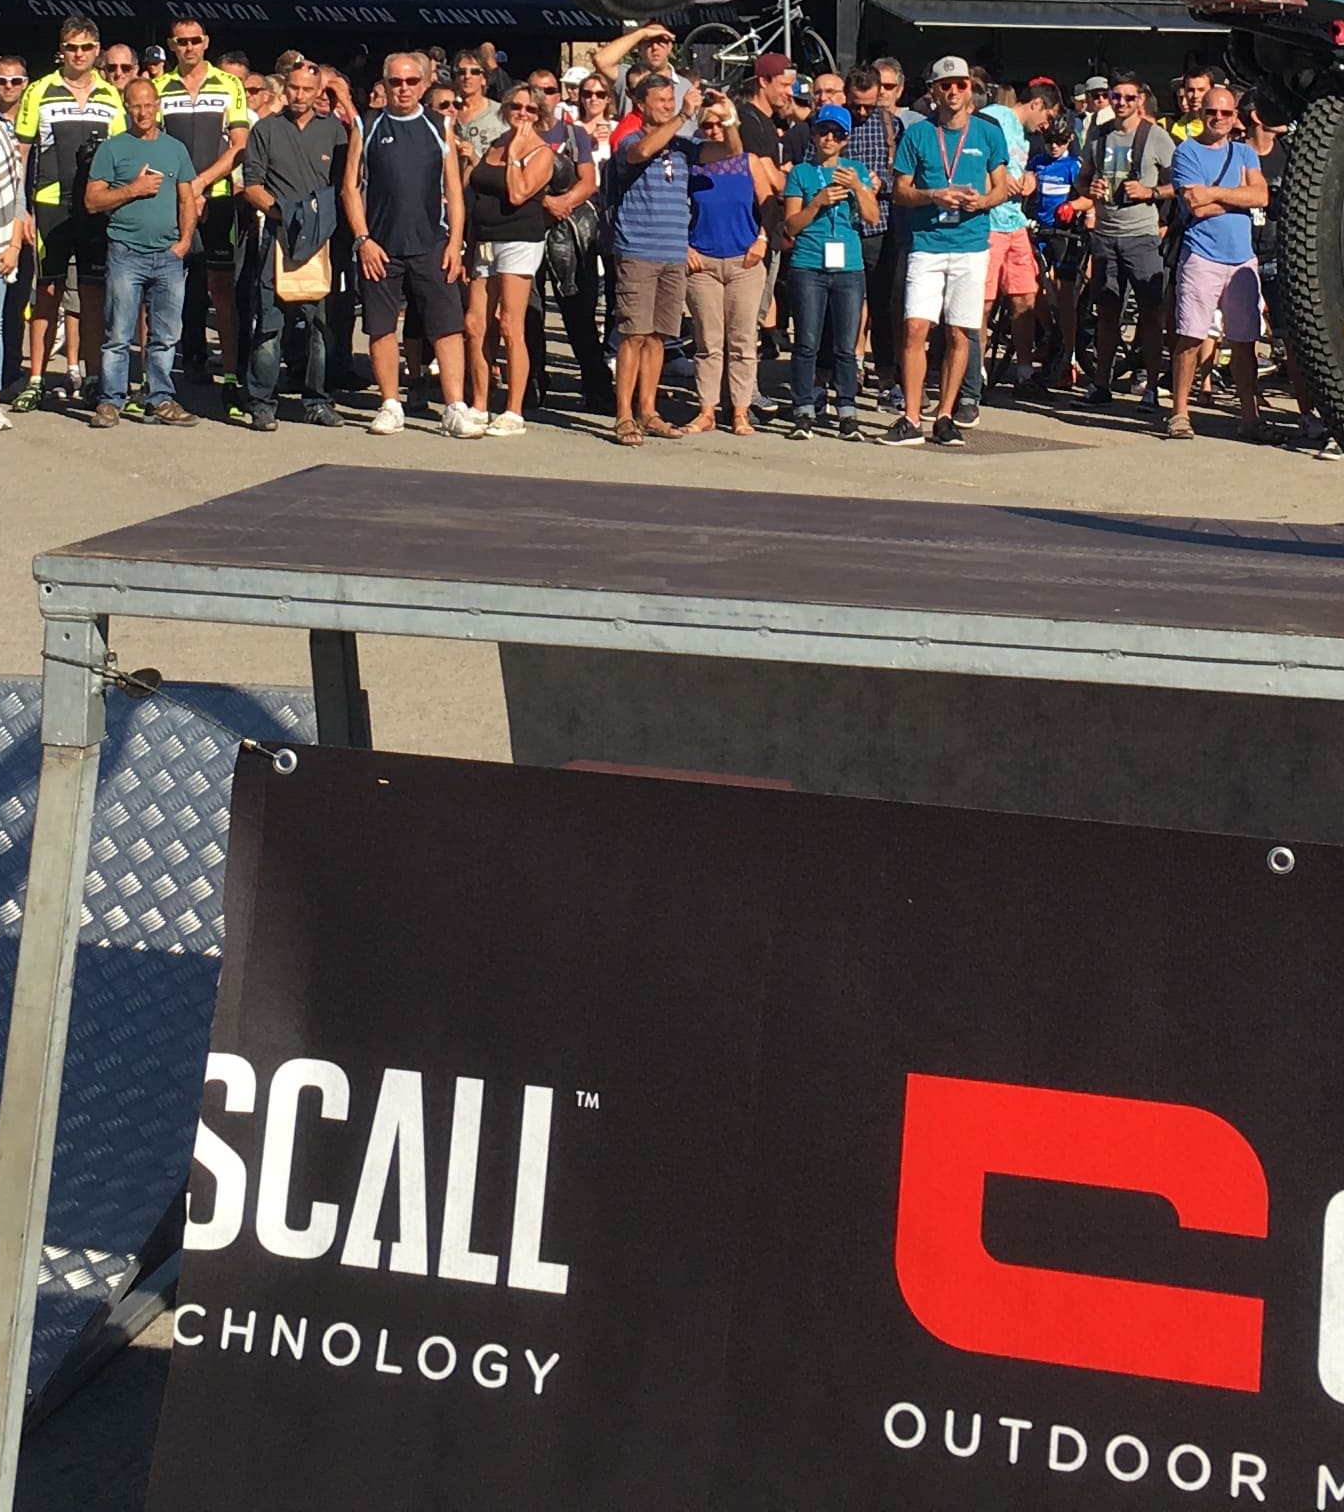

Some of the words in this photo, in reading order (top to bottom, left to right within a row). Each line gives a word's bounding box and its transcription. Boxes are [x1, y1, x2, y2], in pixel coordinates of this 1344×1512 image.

[166, 0, 270, 21] CANYON
[295, 4, 397, 24] CANYON
[418, 7, 518, 25] CANYON
[51, 107, 111, 117] HEAD
[164, 99, 225, 109] HEAD
[183, 1052, 569, 1294] SCALL
[173, 1303, 560, 1395] CHNOLOGY
[883, 1402, 1268, 1502] OUTDOOR
